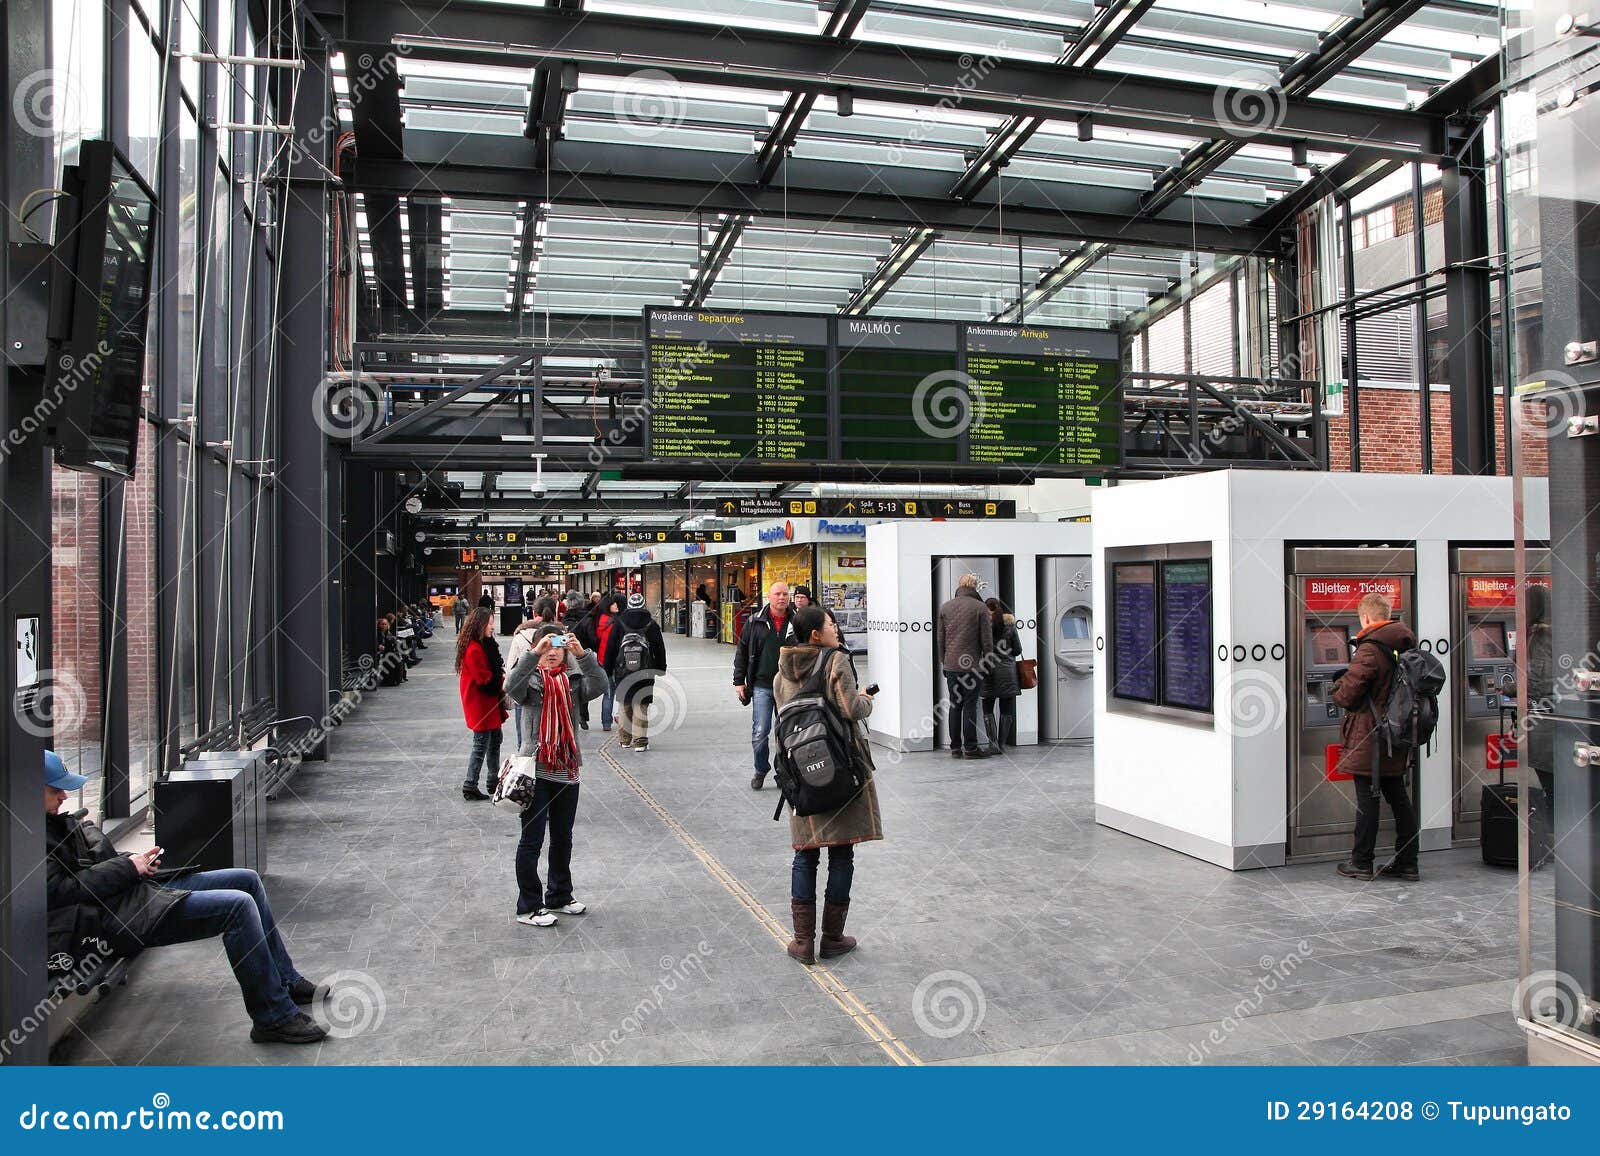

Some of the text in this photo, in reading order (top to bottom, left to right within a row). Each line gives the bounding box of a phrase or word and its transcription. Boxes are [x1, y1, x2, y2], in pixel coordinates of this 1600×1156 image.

[651, 312, 745, 325] Avgående Departures
[850, 321, 901, 335] MALMÖ C
[967, 326, 1049, 339] Ankommande Arrivals
[860, 500, 874, 508] Spår
[878, 502, 897, 512] 5-13
[958, 501, 971, 509] Buss
[1311, 582, 1395, 596] Biljetter Tickets
[1472, 580, 1509, 593] Biljetter
